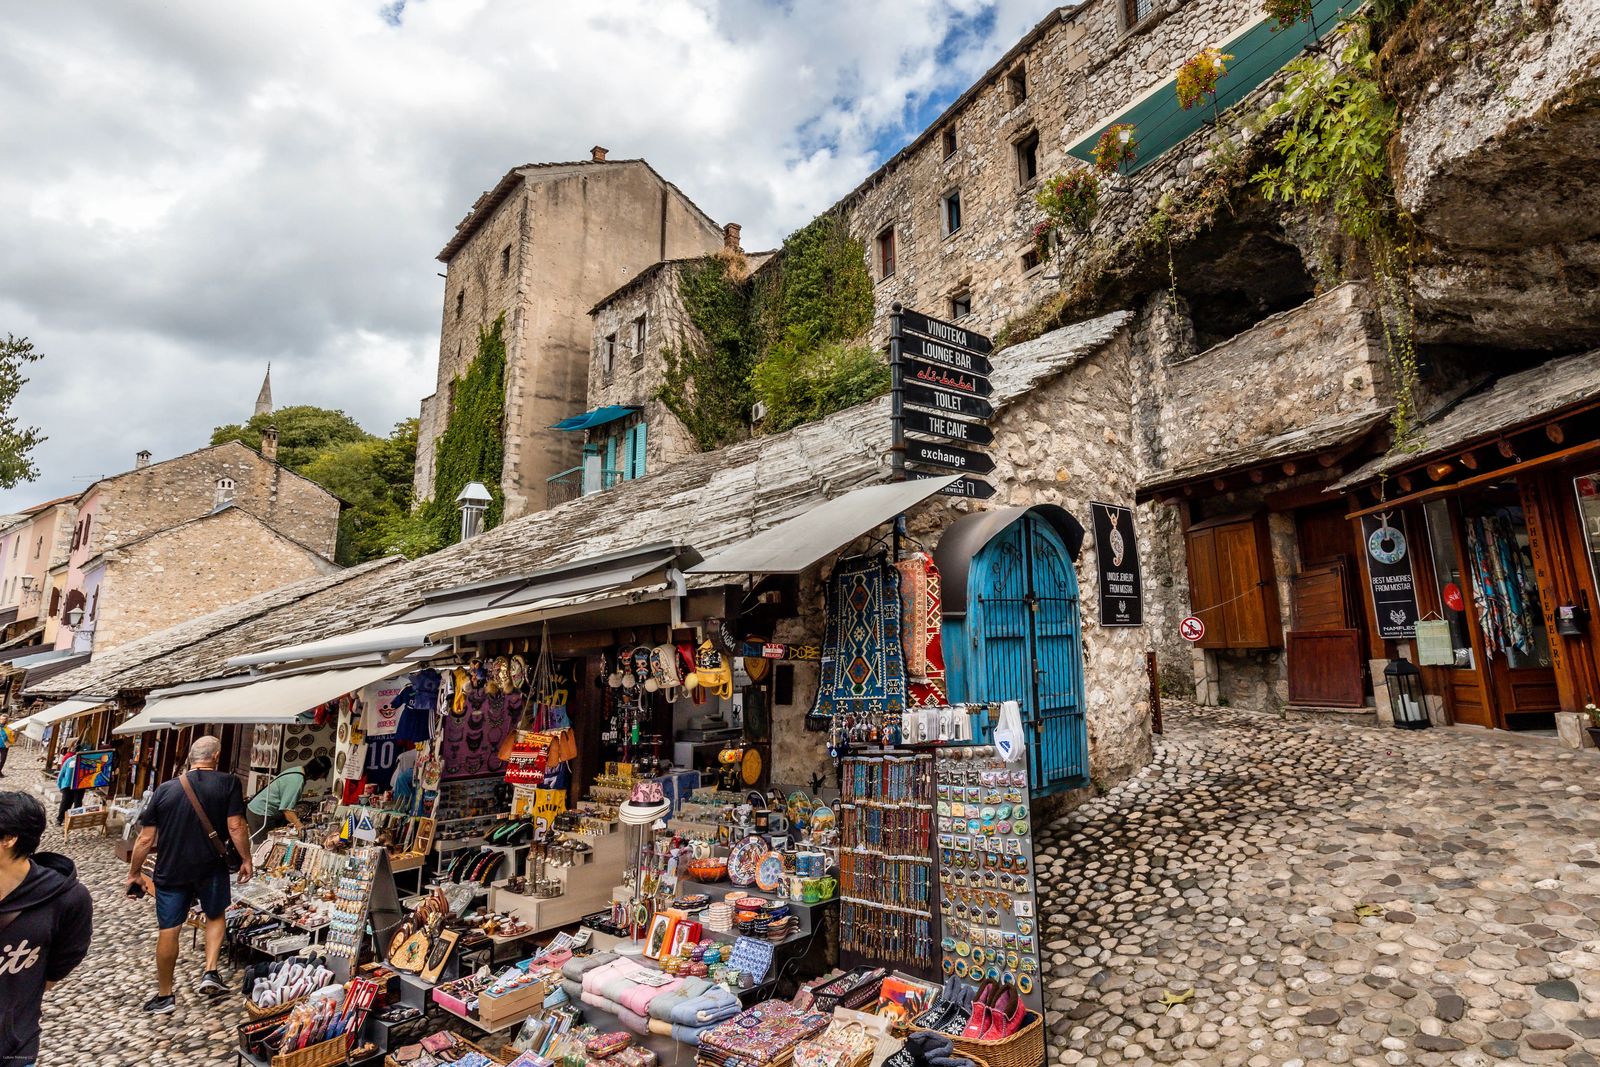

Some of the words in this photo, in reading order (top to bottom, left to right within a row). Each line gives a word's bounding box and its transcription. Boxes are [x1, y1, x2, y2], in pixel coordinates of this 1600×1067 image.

[927, 319, 967, 347] VINOTEKA
[922, 341, 954, 364] LOUNGE
[955, 352, 972, 370] BAR
[934, 391, 962, 411] TOILET
[929, 417, 946, 434] THE
[946, 421, 967, 440] CAVE
[921, 448, 966, 466] exchange
[1109, 583, 1120, 593] FROM
[1372, 576, 1385, 585] BEST
[1385, 575, 1412, 584] MEMORIES
[1375, 584, 1390, 592] FROM
[1390, 582, 1411, 591] MOSTAR
[1542, 589, 1561, 670] JEWELRY
[366, 741, 394, 770] 10
